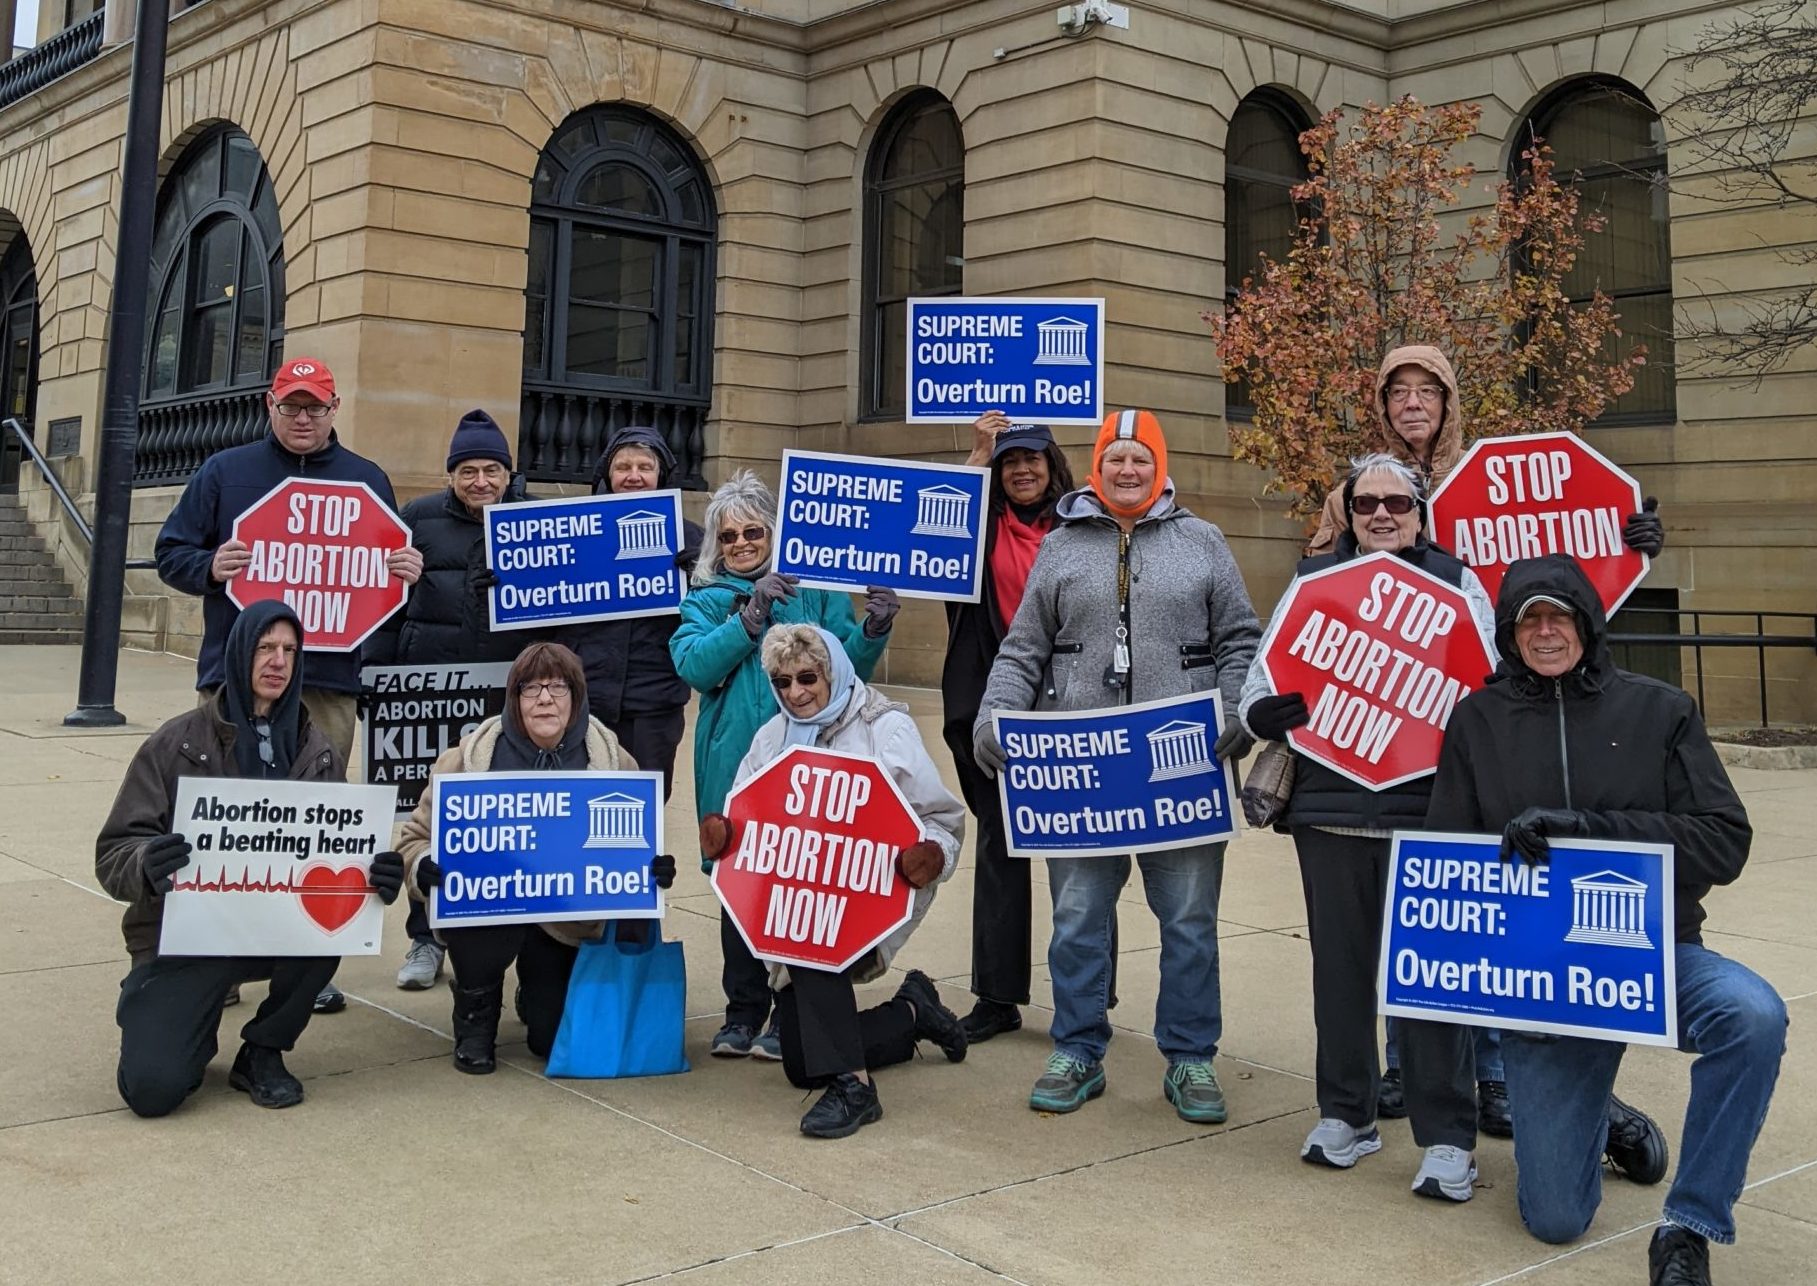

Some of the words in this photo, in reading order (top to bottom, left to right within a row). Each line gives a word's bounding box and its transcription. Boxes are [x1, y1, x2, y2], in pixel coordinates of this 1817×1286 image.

[917, 315, 1023, 337] SUPREME
[917, 342, 994, 365] COURT:
[917, 378, 1026, 404] Overturn
[1035, 379, 1091, 405] Roe!
[791, 470, 903, 503] SUPREME
[1485, 451, 1572, 505] STOP
[287, 492, 361, 537] STOP
[496, 514, 603, 544] SUPREME
[789, 499, 870, 530] COURT:
[1455, 507, 1624, 567] ABORTION
[246, 540, 391, 588] ABORTION
[498, 544, 576, 571] COURT:
[785, 537, 901, 575] Overturn
[909, 549, 970, 580] Roe!
[500, 580, 610, 610] Overturn
[619, 570, 674, 599] Roe!
[1358, 571, 1457, 650] STOP
[374, 671, 438, 693] FACE
[1288, 609, 1472, 731] ABORTION
[375, 698, 485, 721] ABORTION
[1306, 682, 1403, 765] NOW
[1005, 728, 1131, 759] SUPREME
[374, 766, 387, 782] A
[1010, 764, 1101, 790] COURT:
[445, 792, 571, 822] SUPREME
[785, 764, 872, 825] STOP
[1015, 806, 1146, 835] Overturn
[1154, 788, 1223, 827] Roe!
[191, 796, 297, 824] Abortion
[303, 804, 364, 831] stops
[196, 832, 213, 851] a
[218, 826, 311, 860] beating
[316, 829, 376, 855] heart
[445, 825, 536, 854] COURT:
[734, 820, 900, 897] ABORTION
[444, 869, 574, 902] Overturn
[585, 865, 649, 895] Roe!
[1402, 857, 1550, 898] SUPREME
[763, 884, 848, 948] NOW
[1400, 895, 1506, 936] COURT:
[1395, 948, 1554, 1002] Overturn
[1568, 965, 1655, 1012] Roe!
